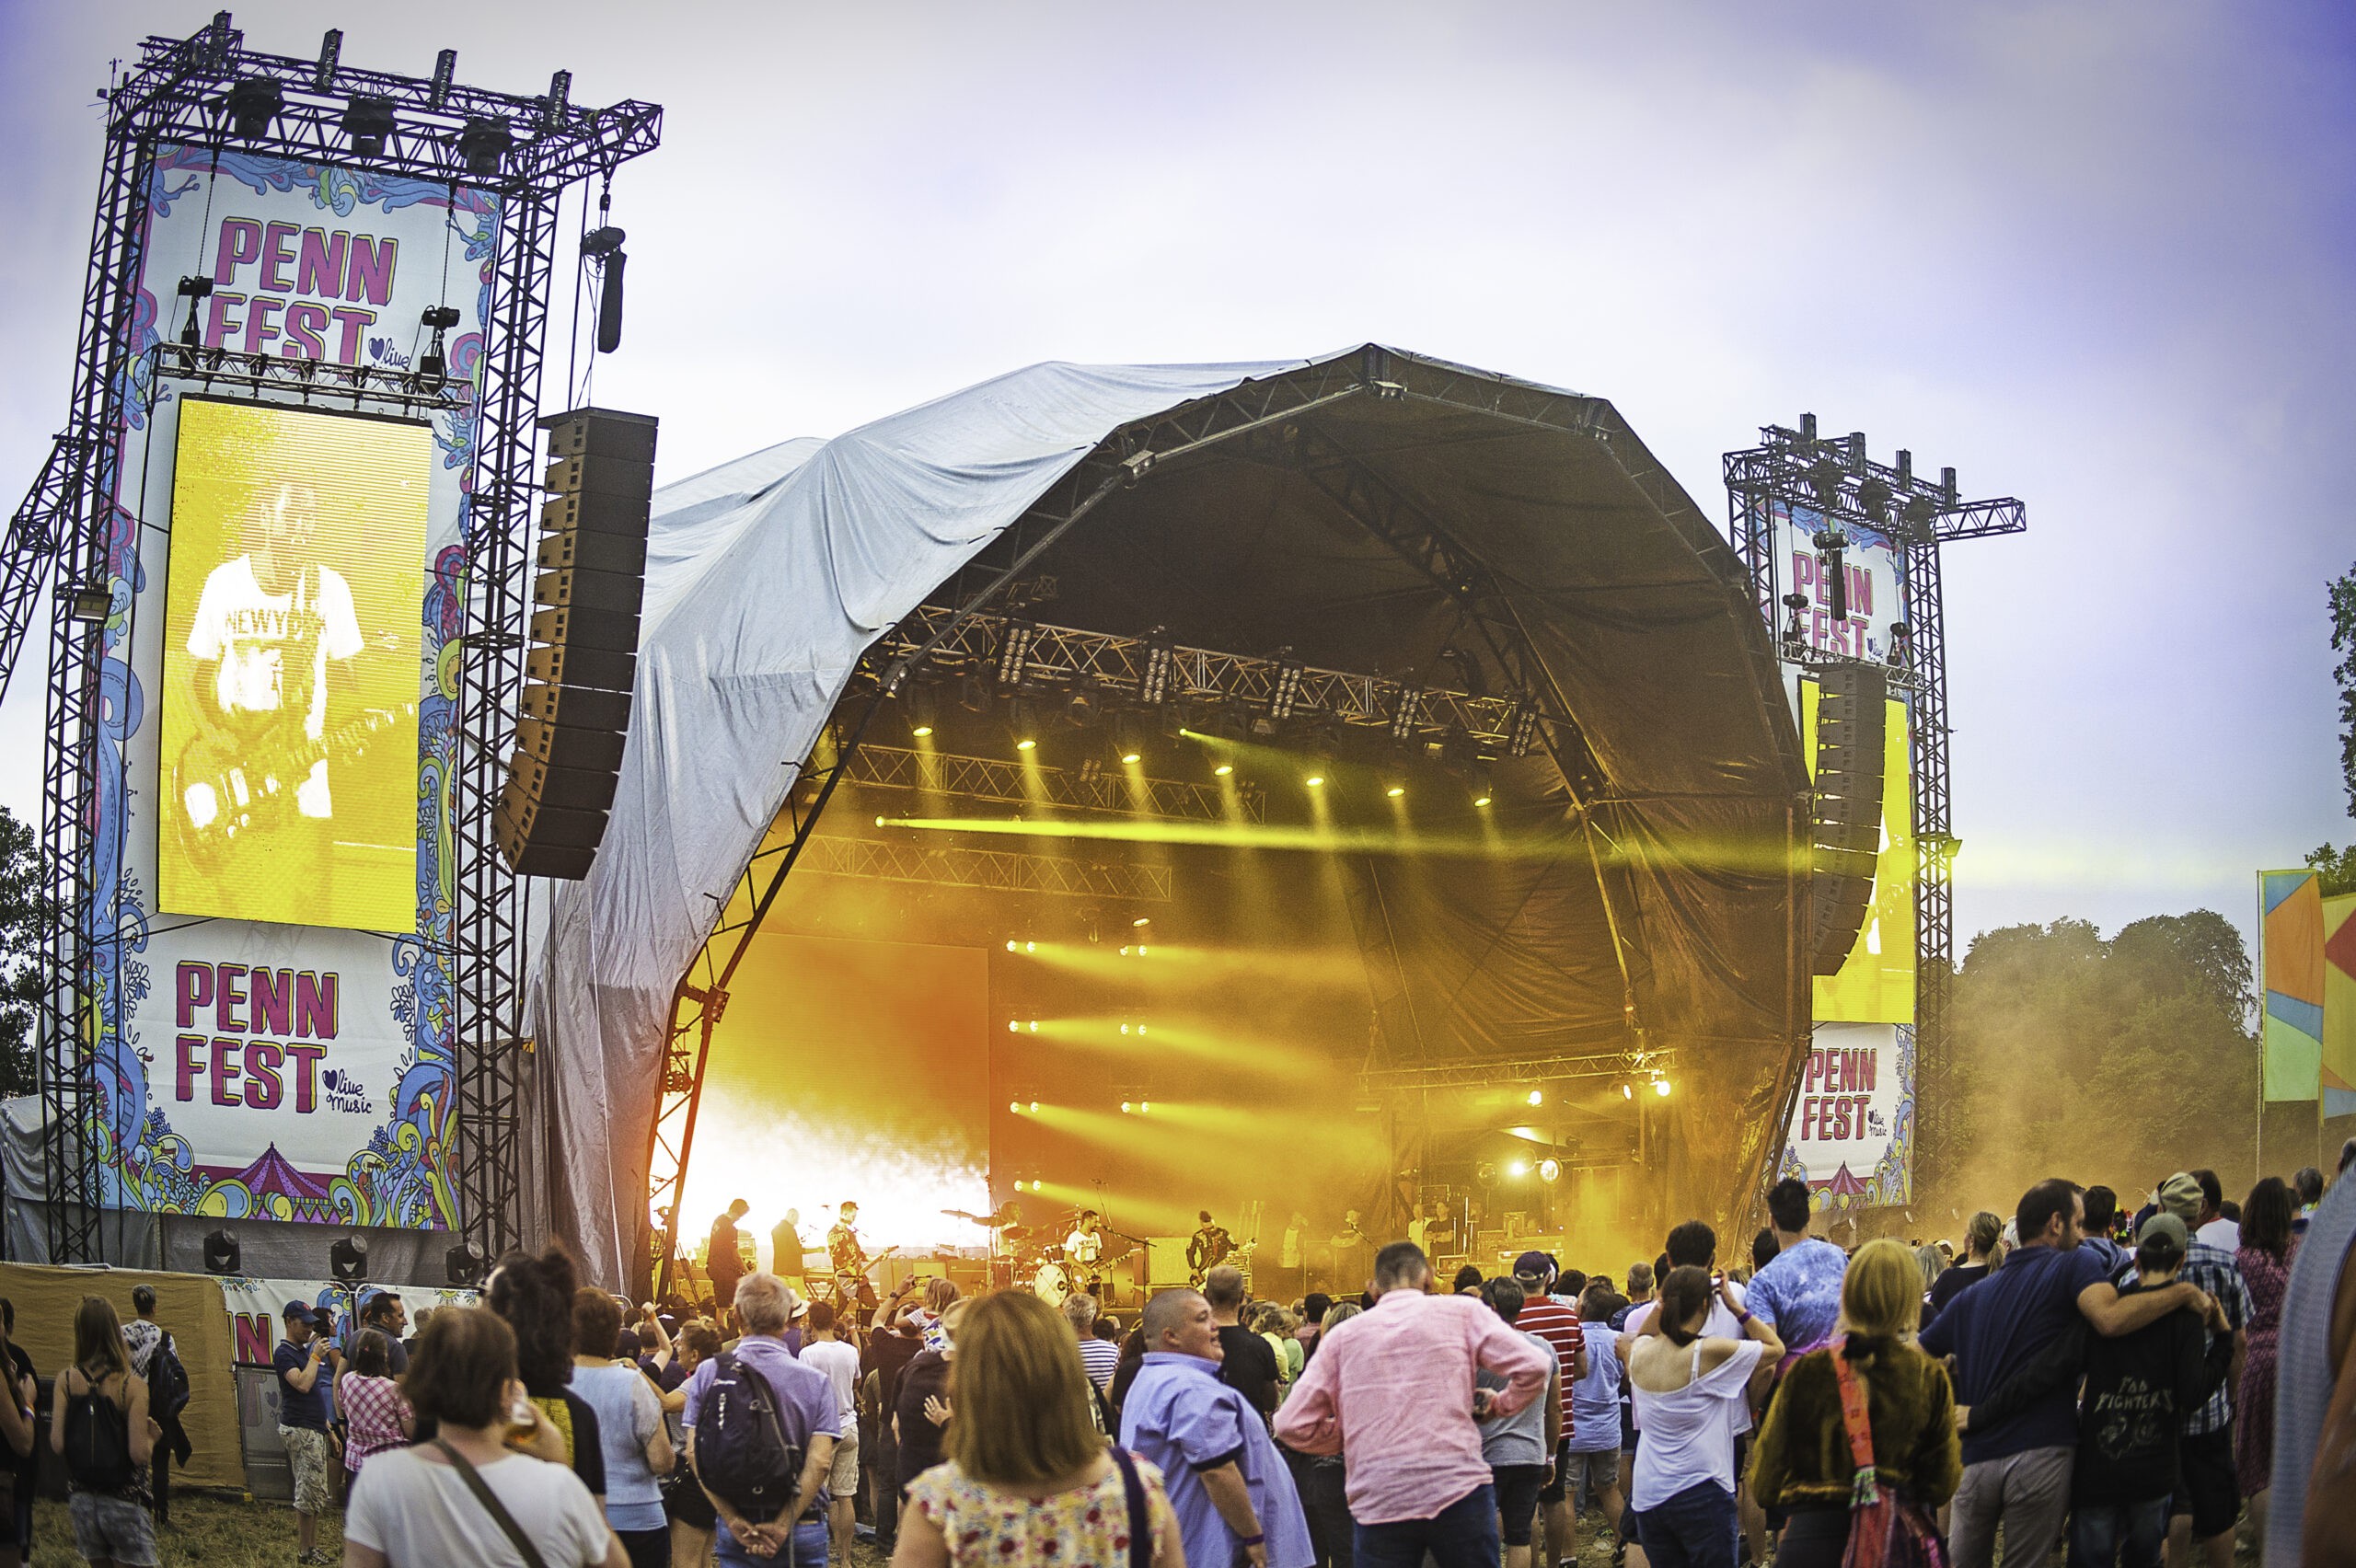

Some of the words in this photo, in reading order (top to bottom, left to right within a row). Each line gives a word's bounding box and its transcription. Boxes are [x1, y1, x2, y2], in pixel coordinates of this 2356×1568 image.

[214, 216, 398, 306] PENN
[204, 291, 377, 379] FEST
[382, 337, 410, 369] live
[176, 959, 339, 1040] PENN
[176, 1032, 328, 1114] FEST
[335, 1067, 364, 1097] live
[1805, 1048, 1877, 1092] PENN
[326, 1089, 373, 1114] music
[1801, 1095, 1871, 1140] FEST
[2093, 1388, 2175, 1414] FIGHTERS
